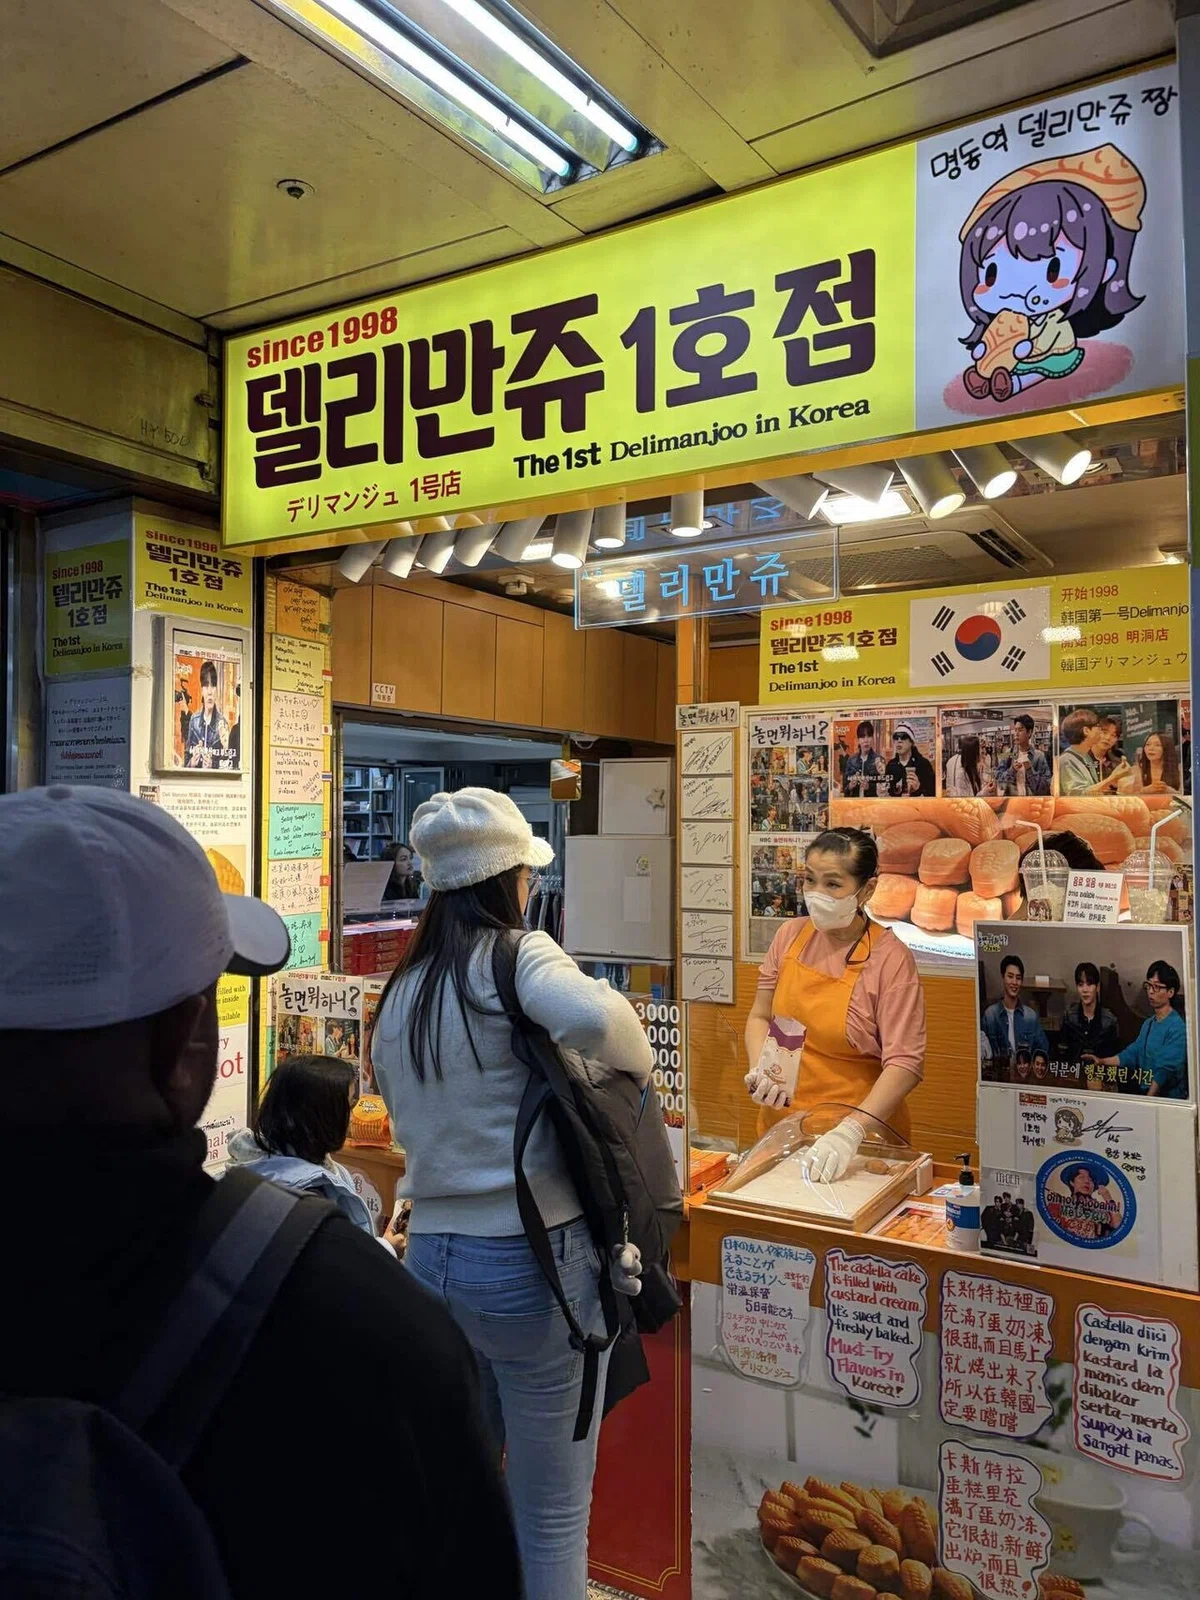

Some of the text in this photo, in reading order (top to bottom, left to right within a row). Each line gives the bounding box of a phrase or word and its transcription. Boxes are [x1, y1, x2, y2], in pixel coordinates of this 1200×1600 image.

[930, 86, 1178, 180] 명동역 델리만쥬 짱
[610, 420, 748, 463] Delimanjoo
[755, 413, 781, 435] in
[788, 398, 871, 429] Korea
[287, 470, 461, 523] デリマンジュ 1号店
[146, 542, 243, 578] 델리만쥬
[53, 575, 123, 608] 델리만쥬
[168, 568, 223, 591] 1호점
[145, 590, 244, 614] Delimanjoo in Korea
[68, 604, 107, 628] 1호점
[1126, 628, 1168, 644] 明洞店
[53, 646, 92, 658] Delimanjoo
[102, 642, 123, 651] Korea
[375, 685, 394, 694] CCTV
[769, 674, 896, 692] Delimanjoo in Korea
[1085, 1067, 1128, 1084] 행복했던
[1132, 1071, 1154, 1086] 시간
[828, 1255, 921, 1284] The castella cake
[833, 1275, 897, 1294] is filled with
[943, 1277, 1048, 1316] 卡斯特拉裡面
[830, 1290, 922, 1312] custard cream.
[832, 1304, 909, 1329] It's sweet and
[1083, 1312, 1167, 1342] Castella diisi
[833, 1318, 913, 1345] freshly baked.
[1083, 1330, 1130, 1353] dengan
[837, 1358, 905, 1383] Flavors in
[1083, 1350, 1138, 1373] kastard
[852, 1374, 904, 1399] Korea!
[1079, 1381, 1141, 1407] dibakar
[1084, 1368, 1165, 1396] manis dan
[1137, 1429, 1152, 1446] ia
[944, 1449, 1026, 1485] 卡斯特拉
[1135, 1450, 1179, 1470] panas.
